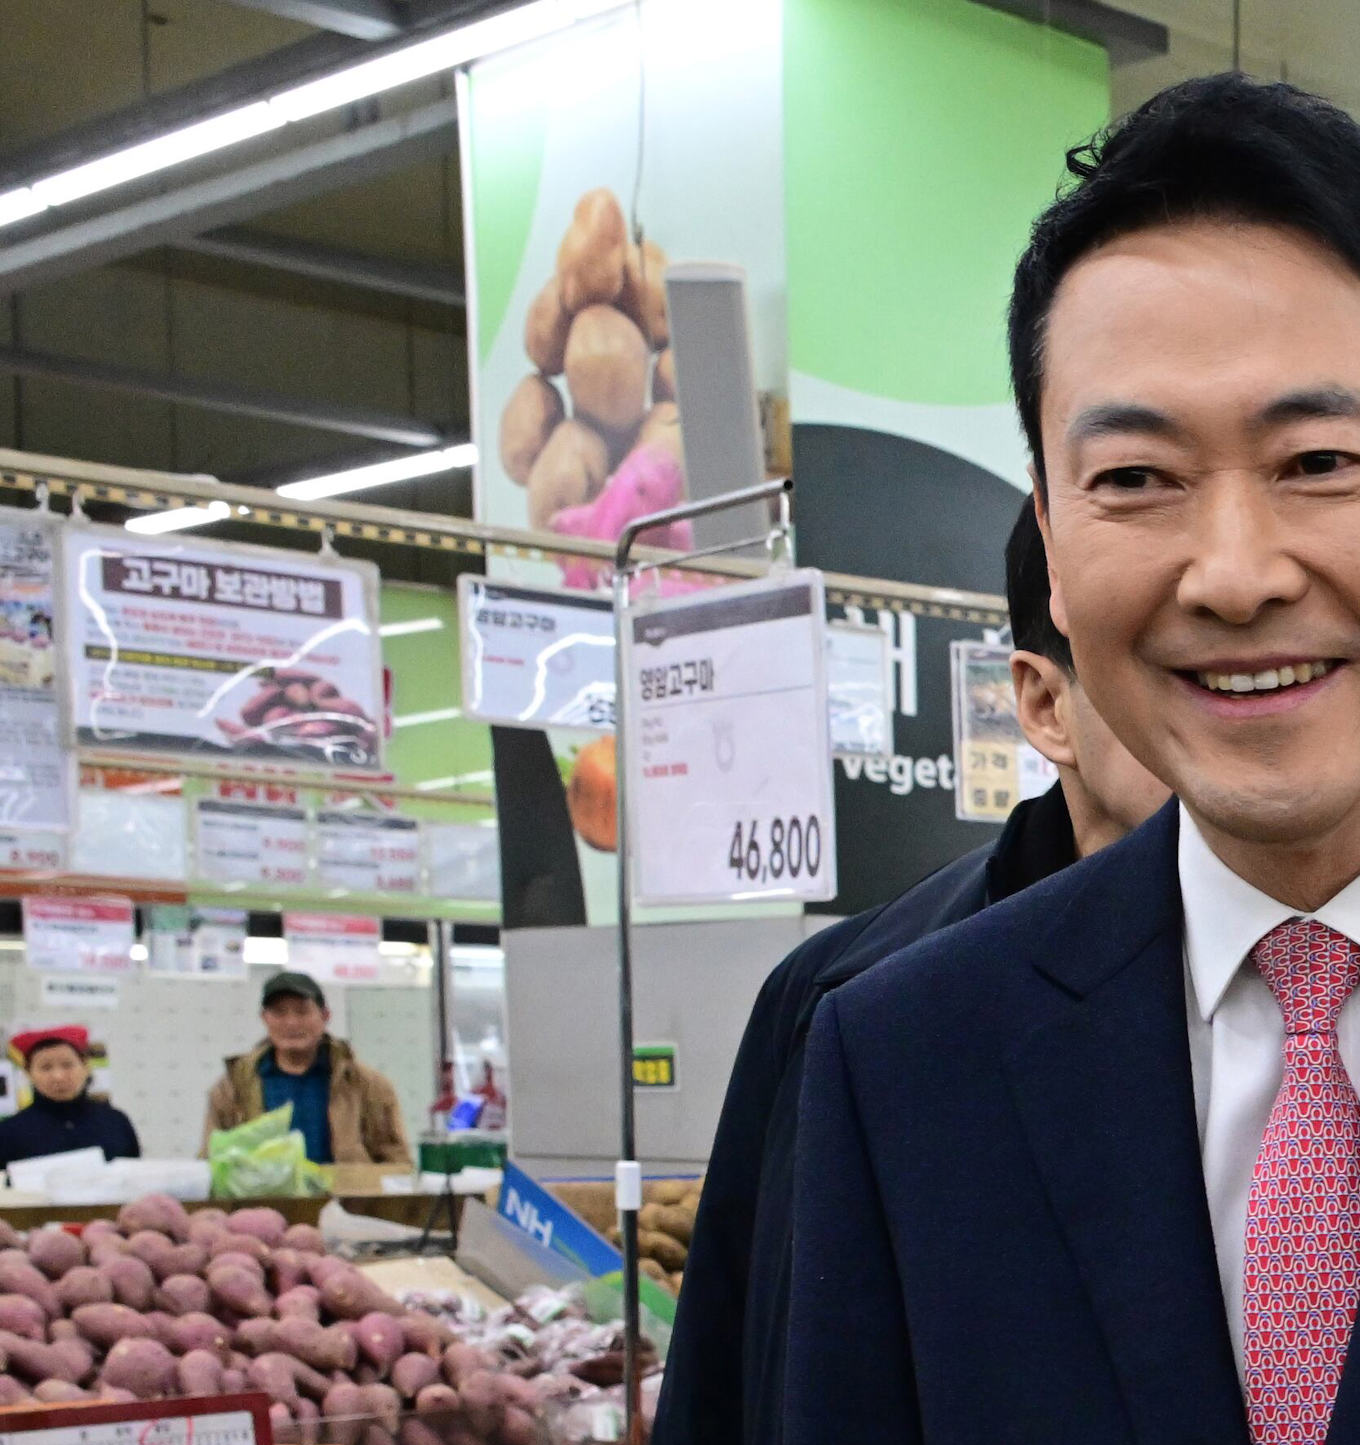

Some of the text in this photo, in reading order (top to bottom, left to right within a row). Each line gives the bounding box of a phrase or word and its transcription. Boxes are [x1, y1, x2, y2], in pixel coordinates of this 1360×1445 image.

[122, 557, 326, 615] 고구마 보관방법
[640, 656, 714, 701] 영암고구마
[729, 814, 821, 884] 46,800
[505, 1187, 553, 1248] NH
